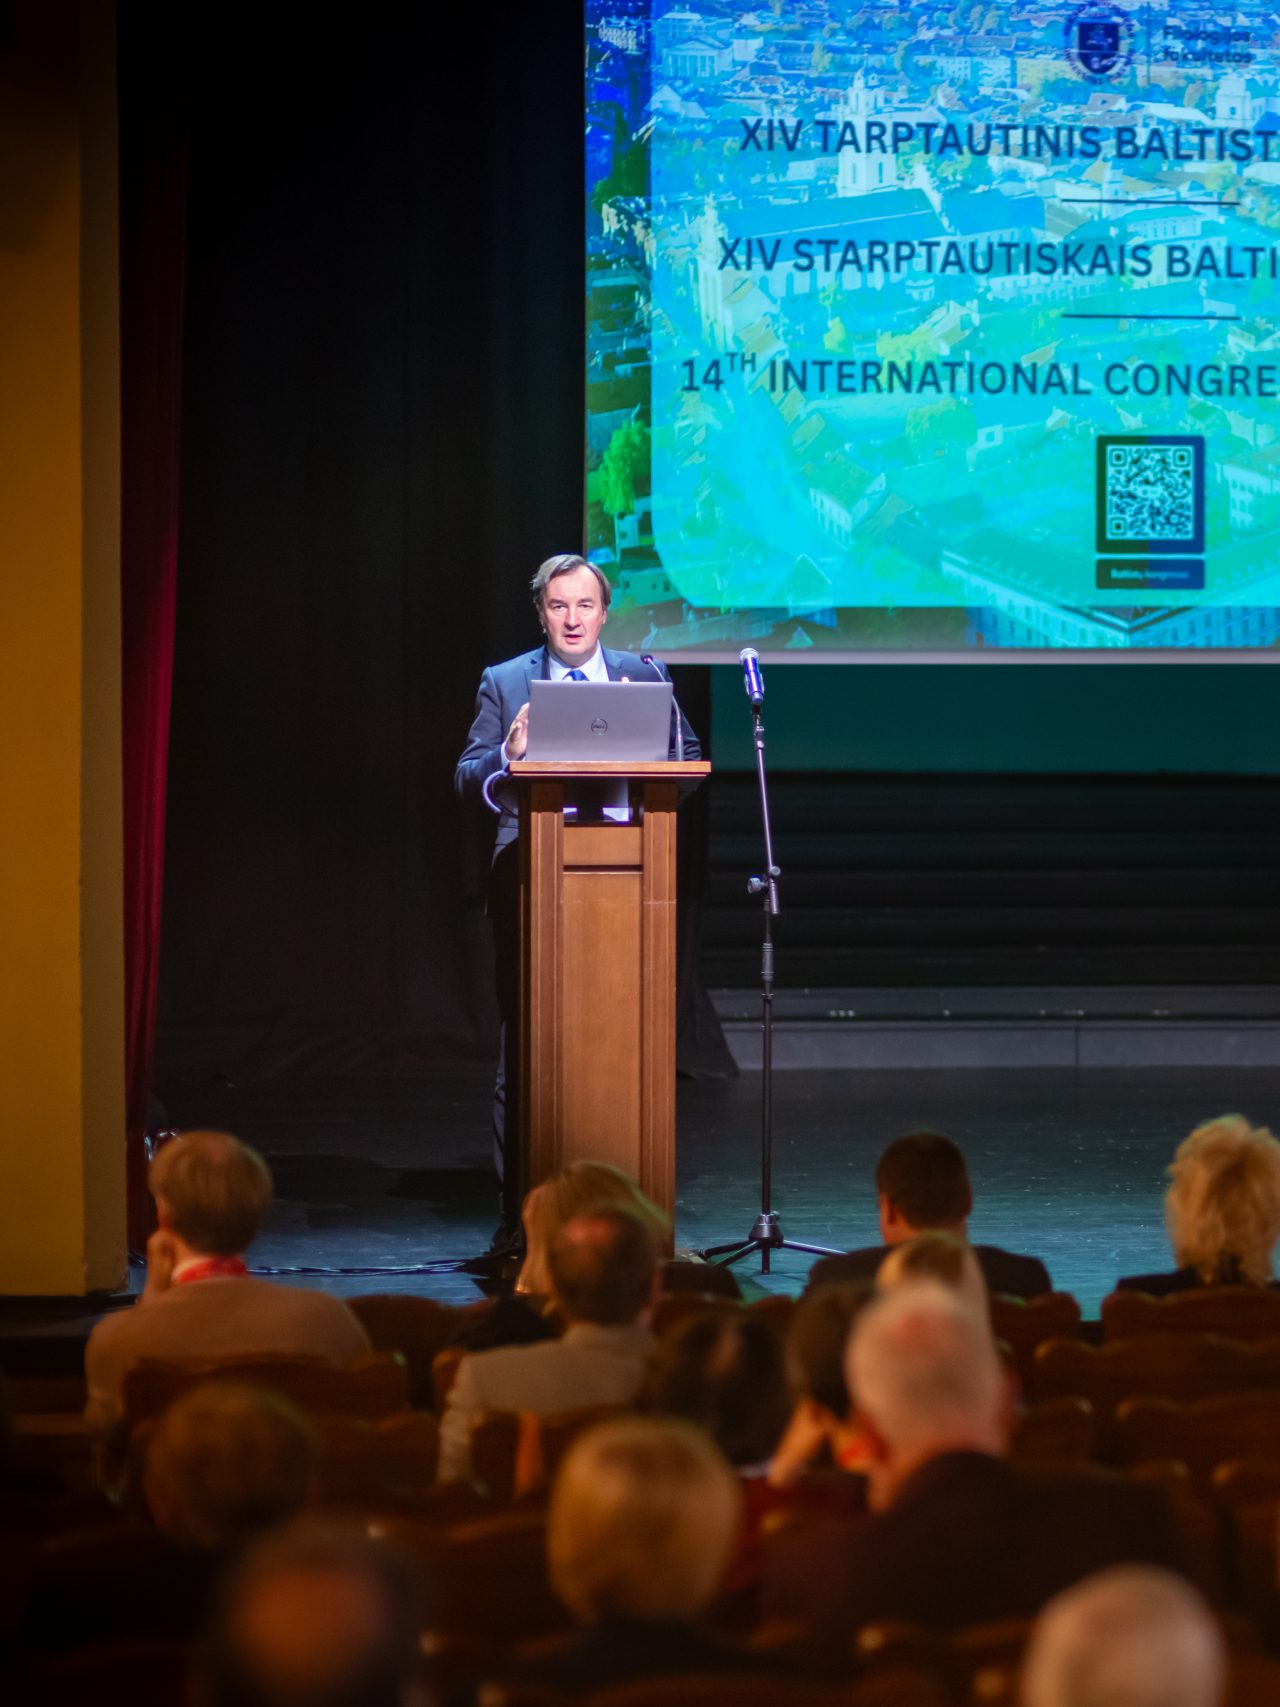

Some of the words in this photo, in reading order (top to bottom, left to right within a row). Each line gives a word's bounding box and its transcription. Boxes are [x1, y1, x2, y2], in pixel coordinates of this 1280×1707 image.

[740, 118, 803, 153] XIV
[816, 121, 1101, 158] TARPTAUTINIS
[718, 237, 781, 272] XIV
[793, 240, 1152, 277] STARPTAUTISKAIS
[770, 361, 1091, 395] INTERNATIONAL
